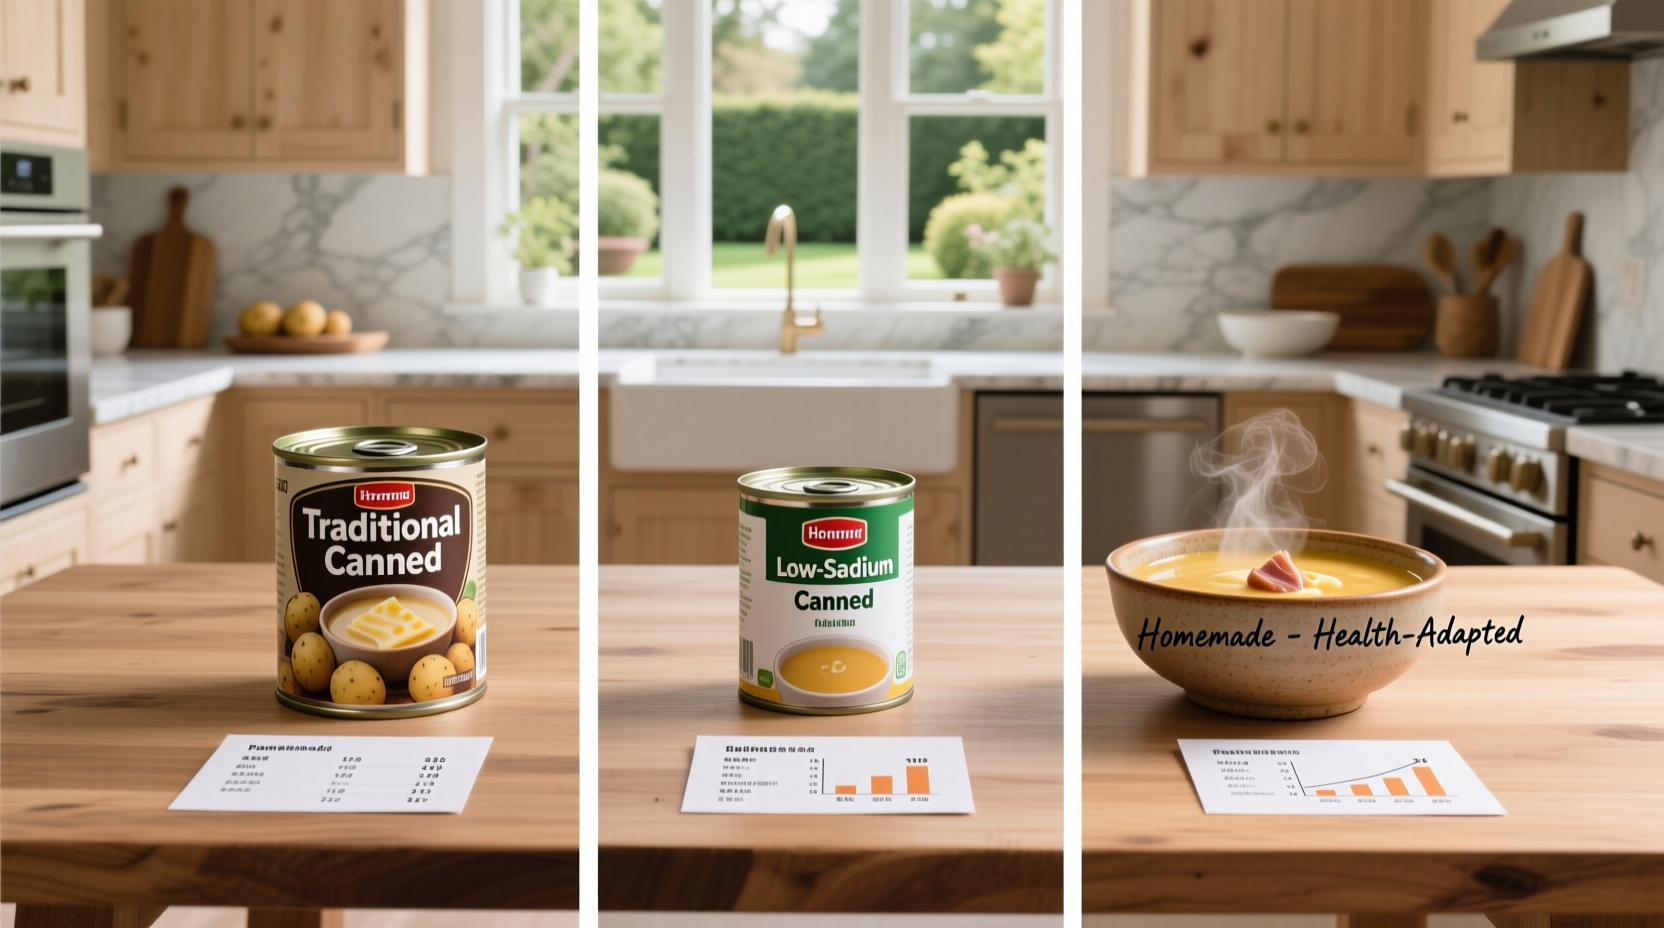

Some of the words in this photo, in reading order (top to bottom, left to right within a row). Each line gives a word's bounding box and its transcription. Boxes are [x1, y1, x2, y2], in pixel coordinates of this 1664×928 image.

[302, 504, 461, 543] Traditional
[324, 541, 442, 577] Canned
[776, 555, 895, 580] Low-Sadium
[794, 588, 874, 611] Canned
